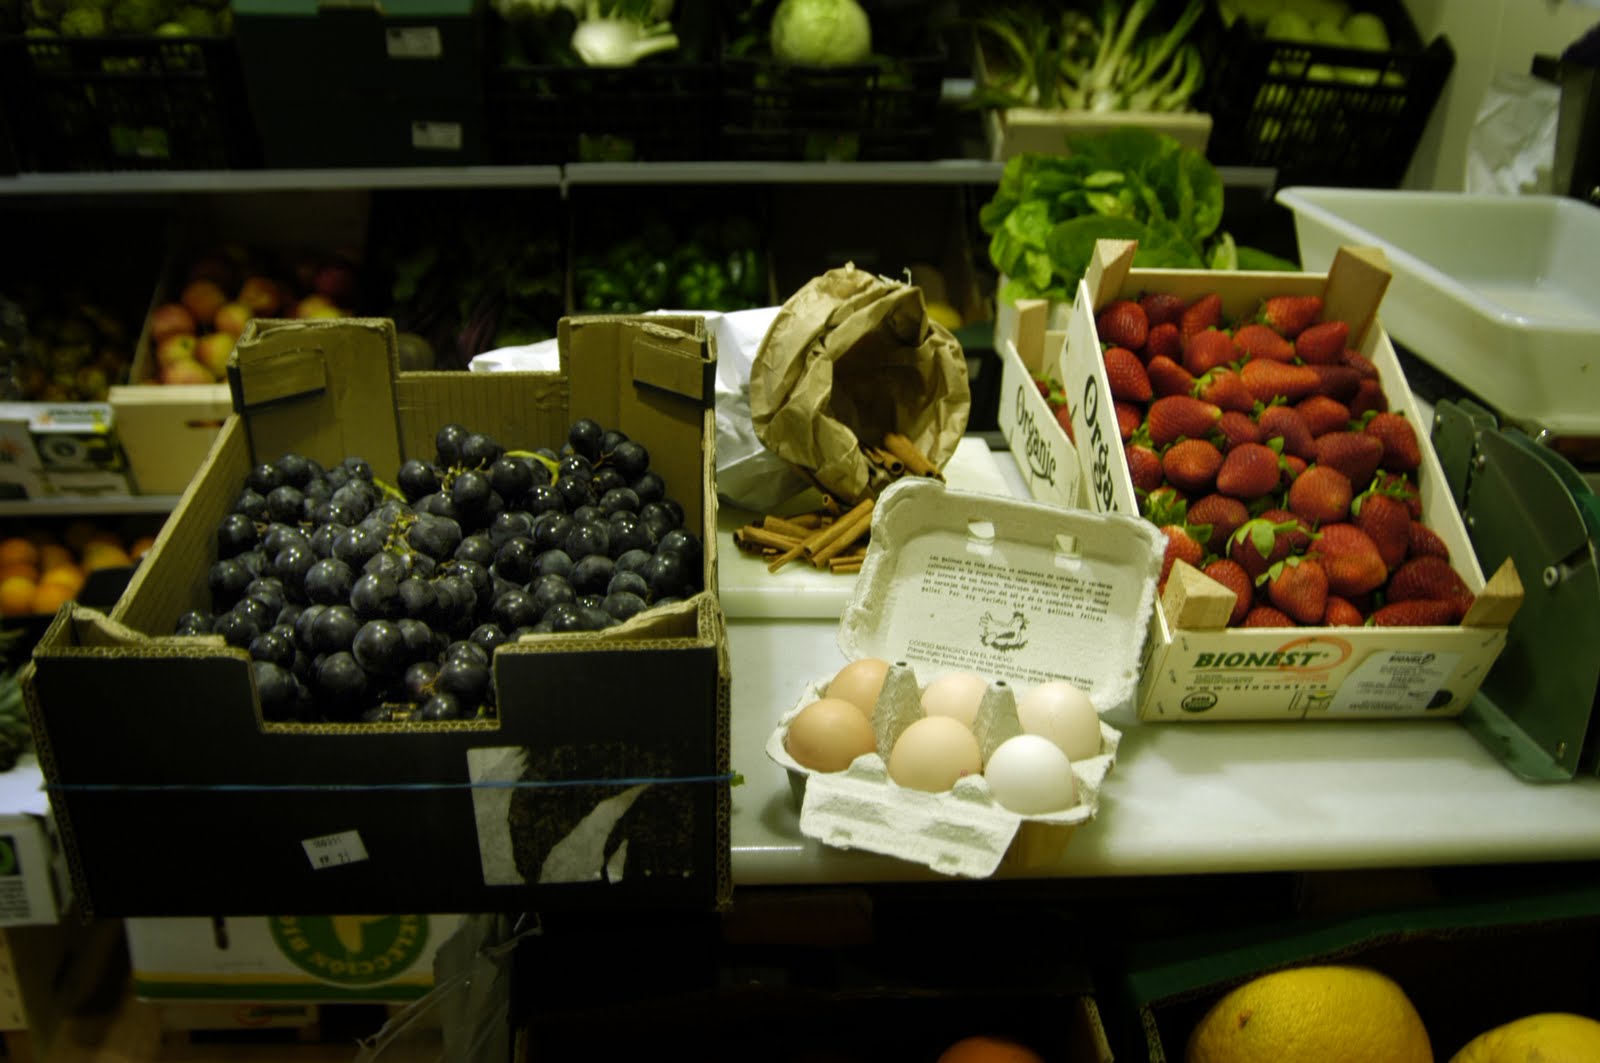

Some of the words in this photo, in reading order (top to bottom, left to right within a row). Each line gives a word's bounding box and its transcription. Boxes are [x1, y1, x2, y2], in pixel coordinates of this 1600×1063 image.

[1016, 384, 1056, 487] Organic
[1084, 374, 1118, 512] Orga
[1193, 652, 1320, 668] BIONEST
